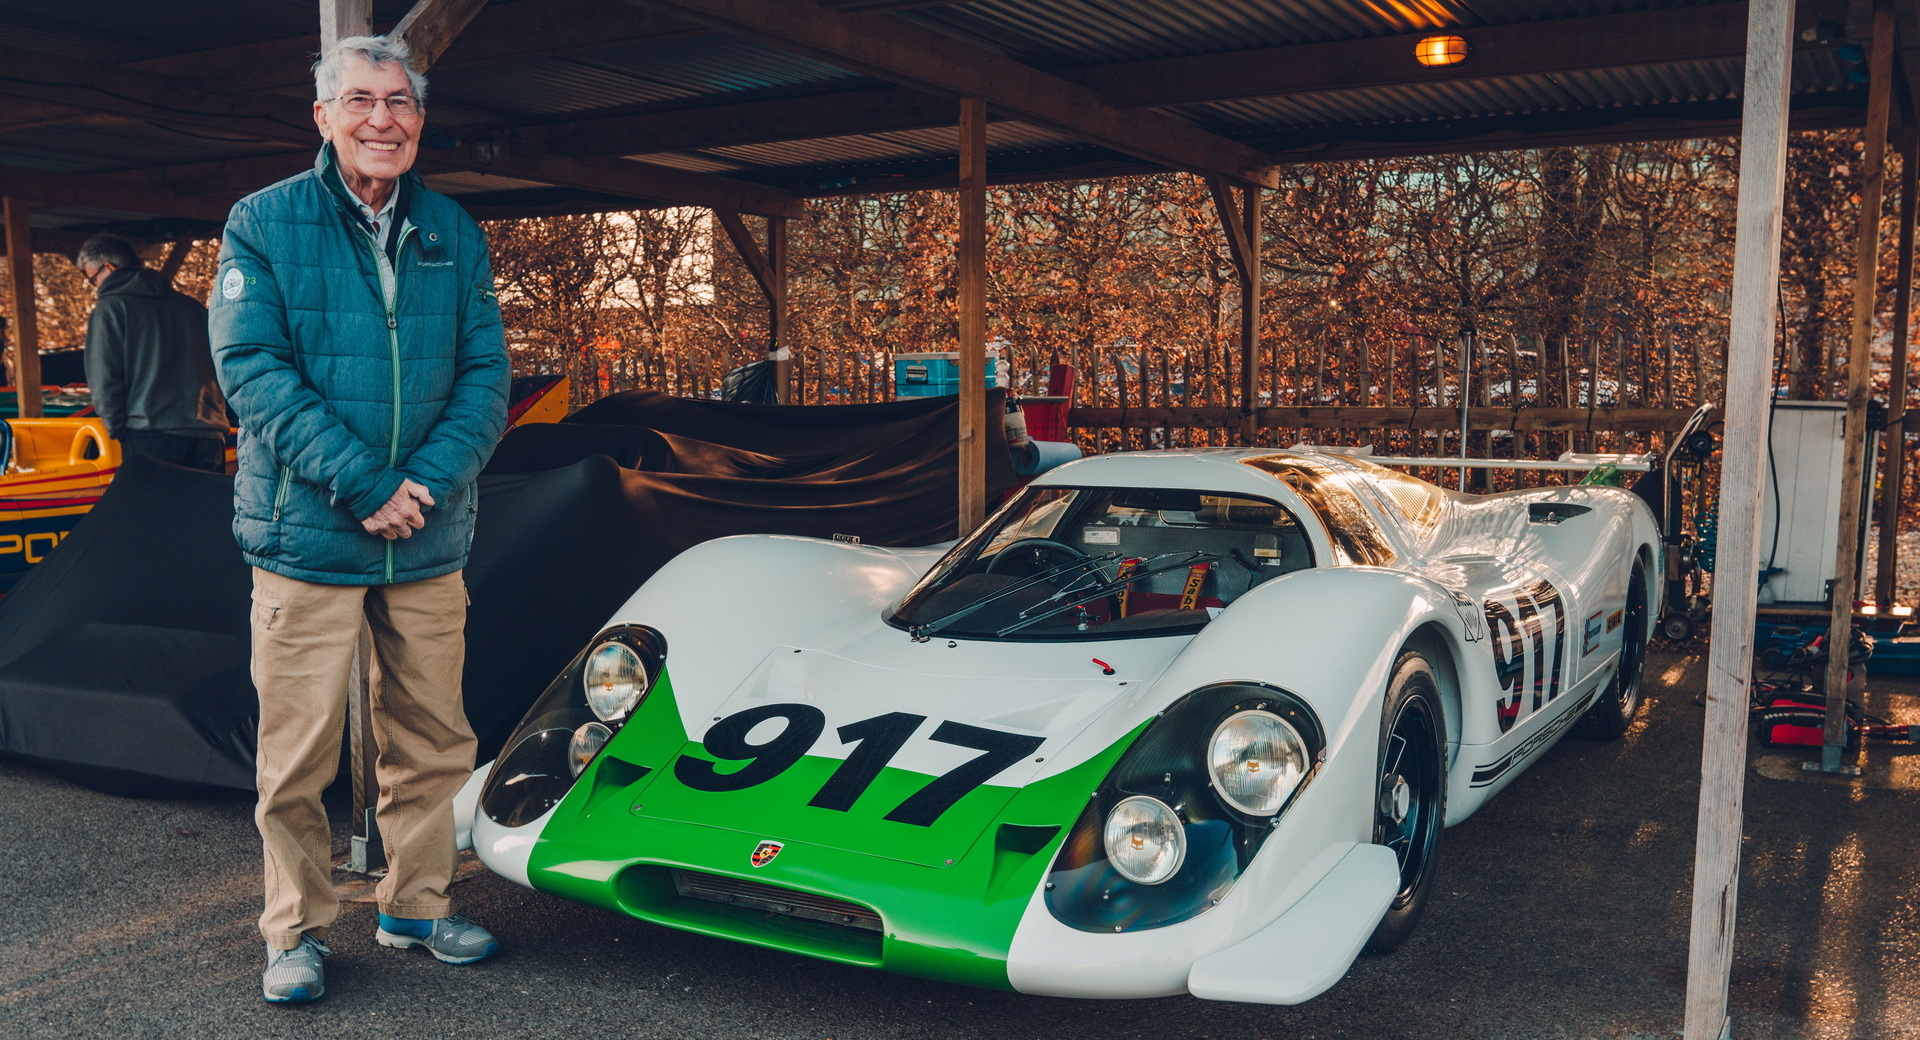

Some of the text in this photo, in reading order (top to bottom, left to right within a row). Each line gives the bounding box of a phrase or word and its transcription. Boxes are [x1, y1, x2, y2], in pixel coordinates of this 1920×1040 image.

[245, 276, 257, 285] 73
[0, 531, 70, 564] PO
[1483, 578, 1566, 735] 917
[673, 702, 1048, 828] 917
[1511, 705, 1578, 765] PORSCHE
